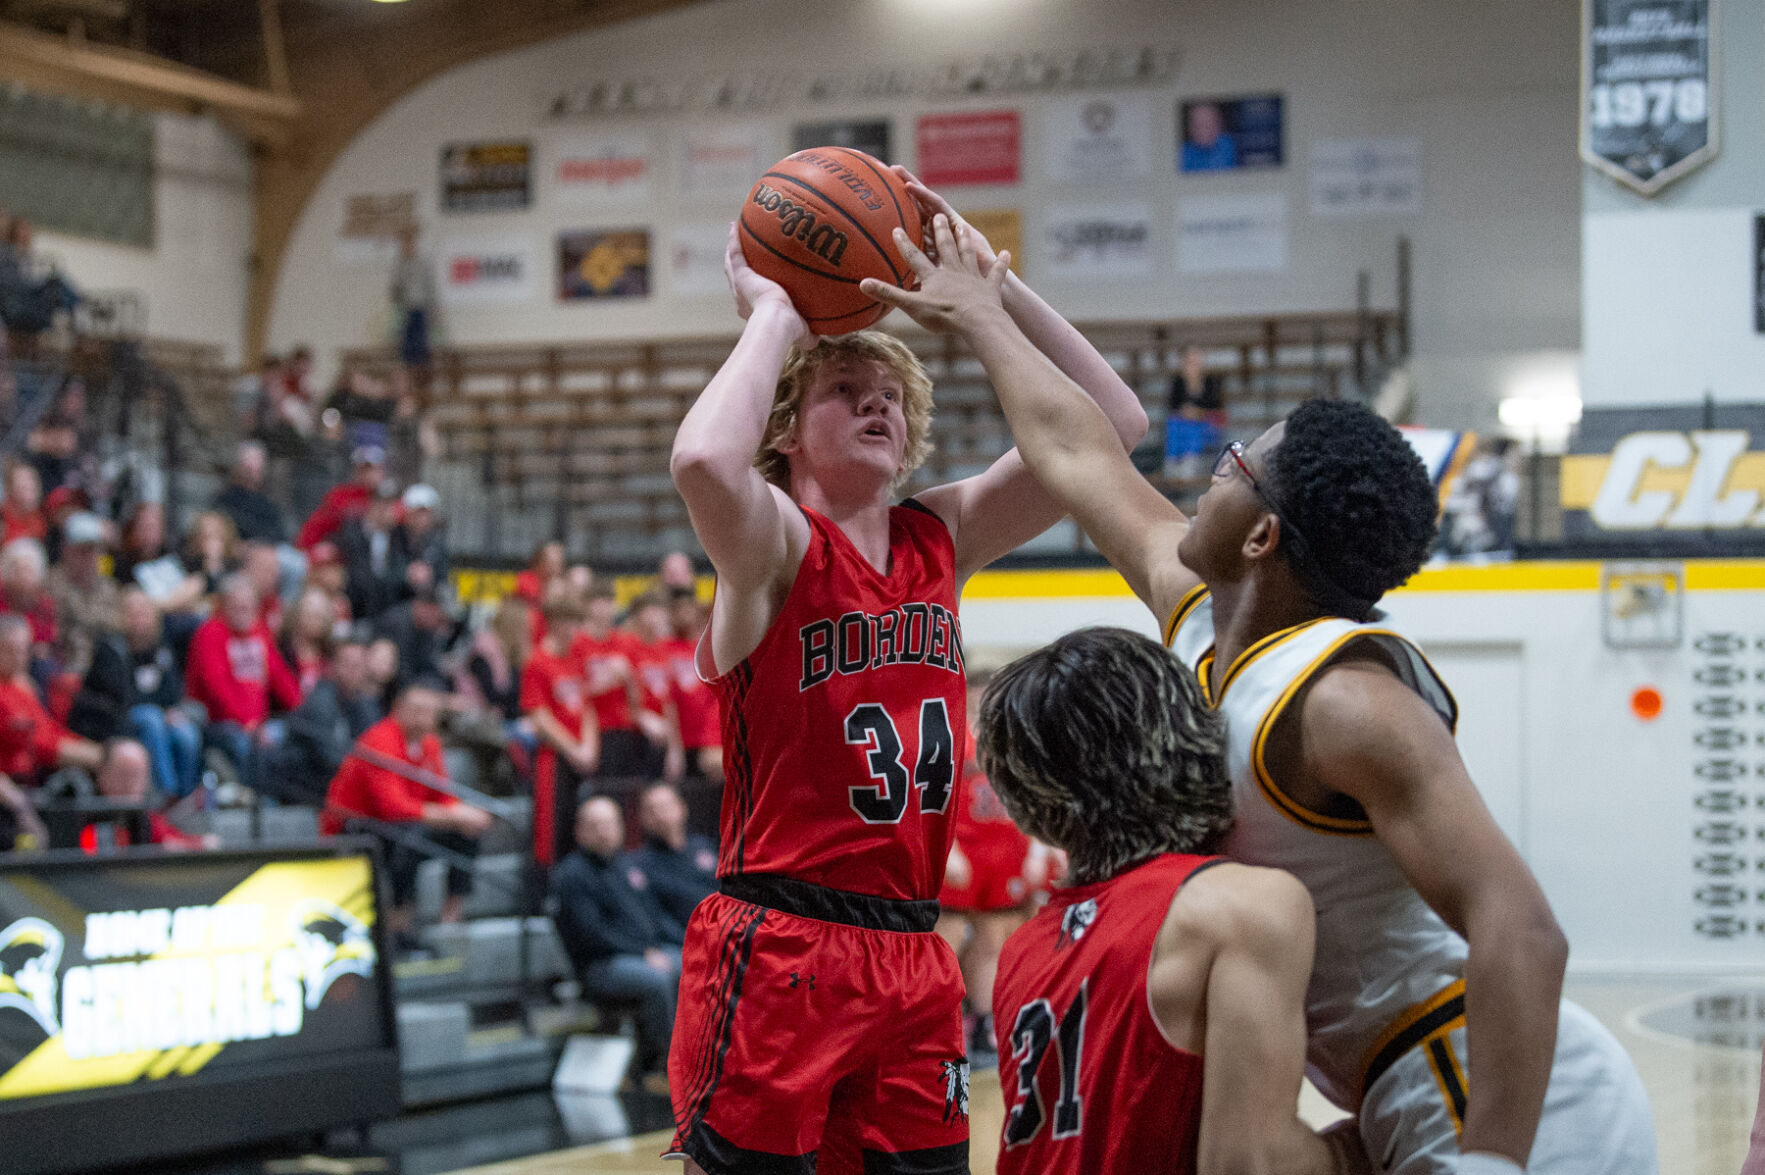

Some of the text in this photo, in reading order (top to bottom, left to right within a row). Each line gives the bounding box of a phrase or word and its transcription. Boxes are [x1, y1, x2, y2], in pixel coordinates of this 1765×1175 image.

[752, 184, 849, 268] Wilson
[1592, 430, 1765, 531] CL
[799, 602, 966, 692] BORDEN
[844, 697, 955, 825] 34
[1004, 976, 1090, 1152] 31
